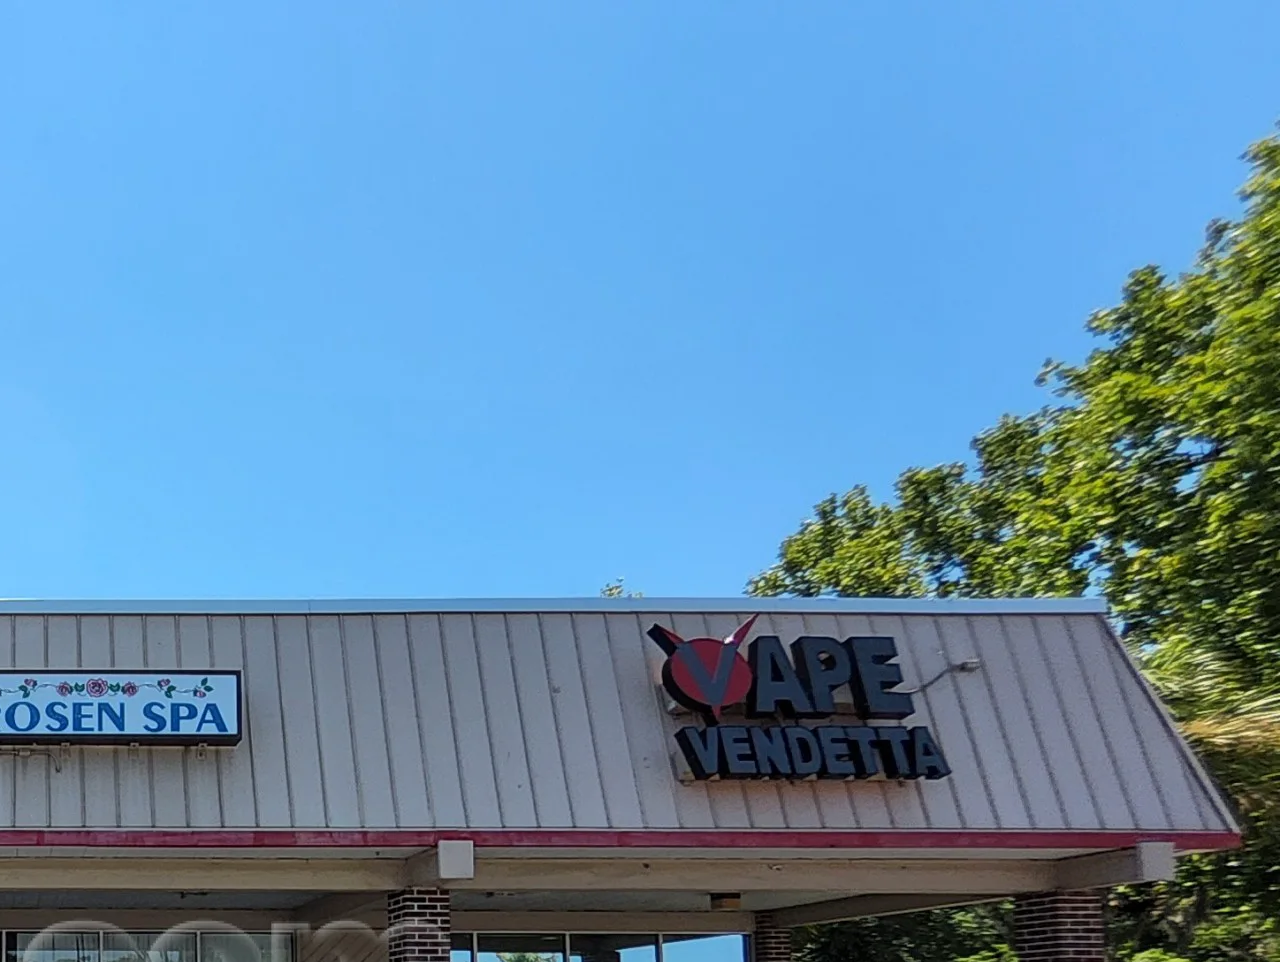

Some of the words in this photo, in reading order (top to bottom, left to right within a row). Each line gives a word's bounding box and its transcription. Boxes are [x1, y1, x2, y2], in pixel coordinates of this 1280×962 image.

[647, 613, 915, 724] VAPE
[142, 701, 229, 732] SPA
[674, 726, 952, 780] VENDETTA
